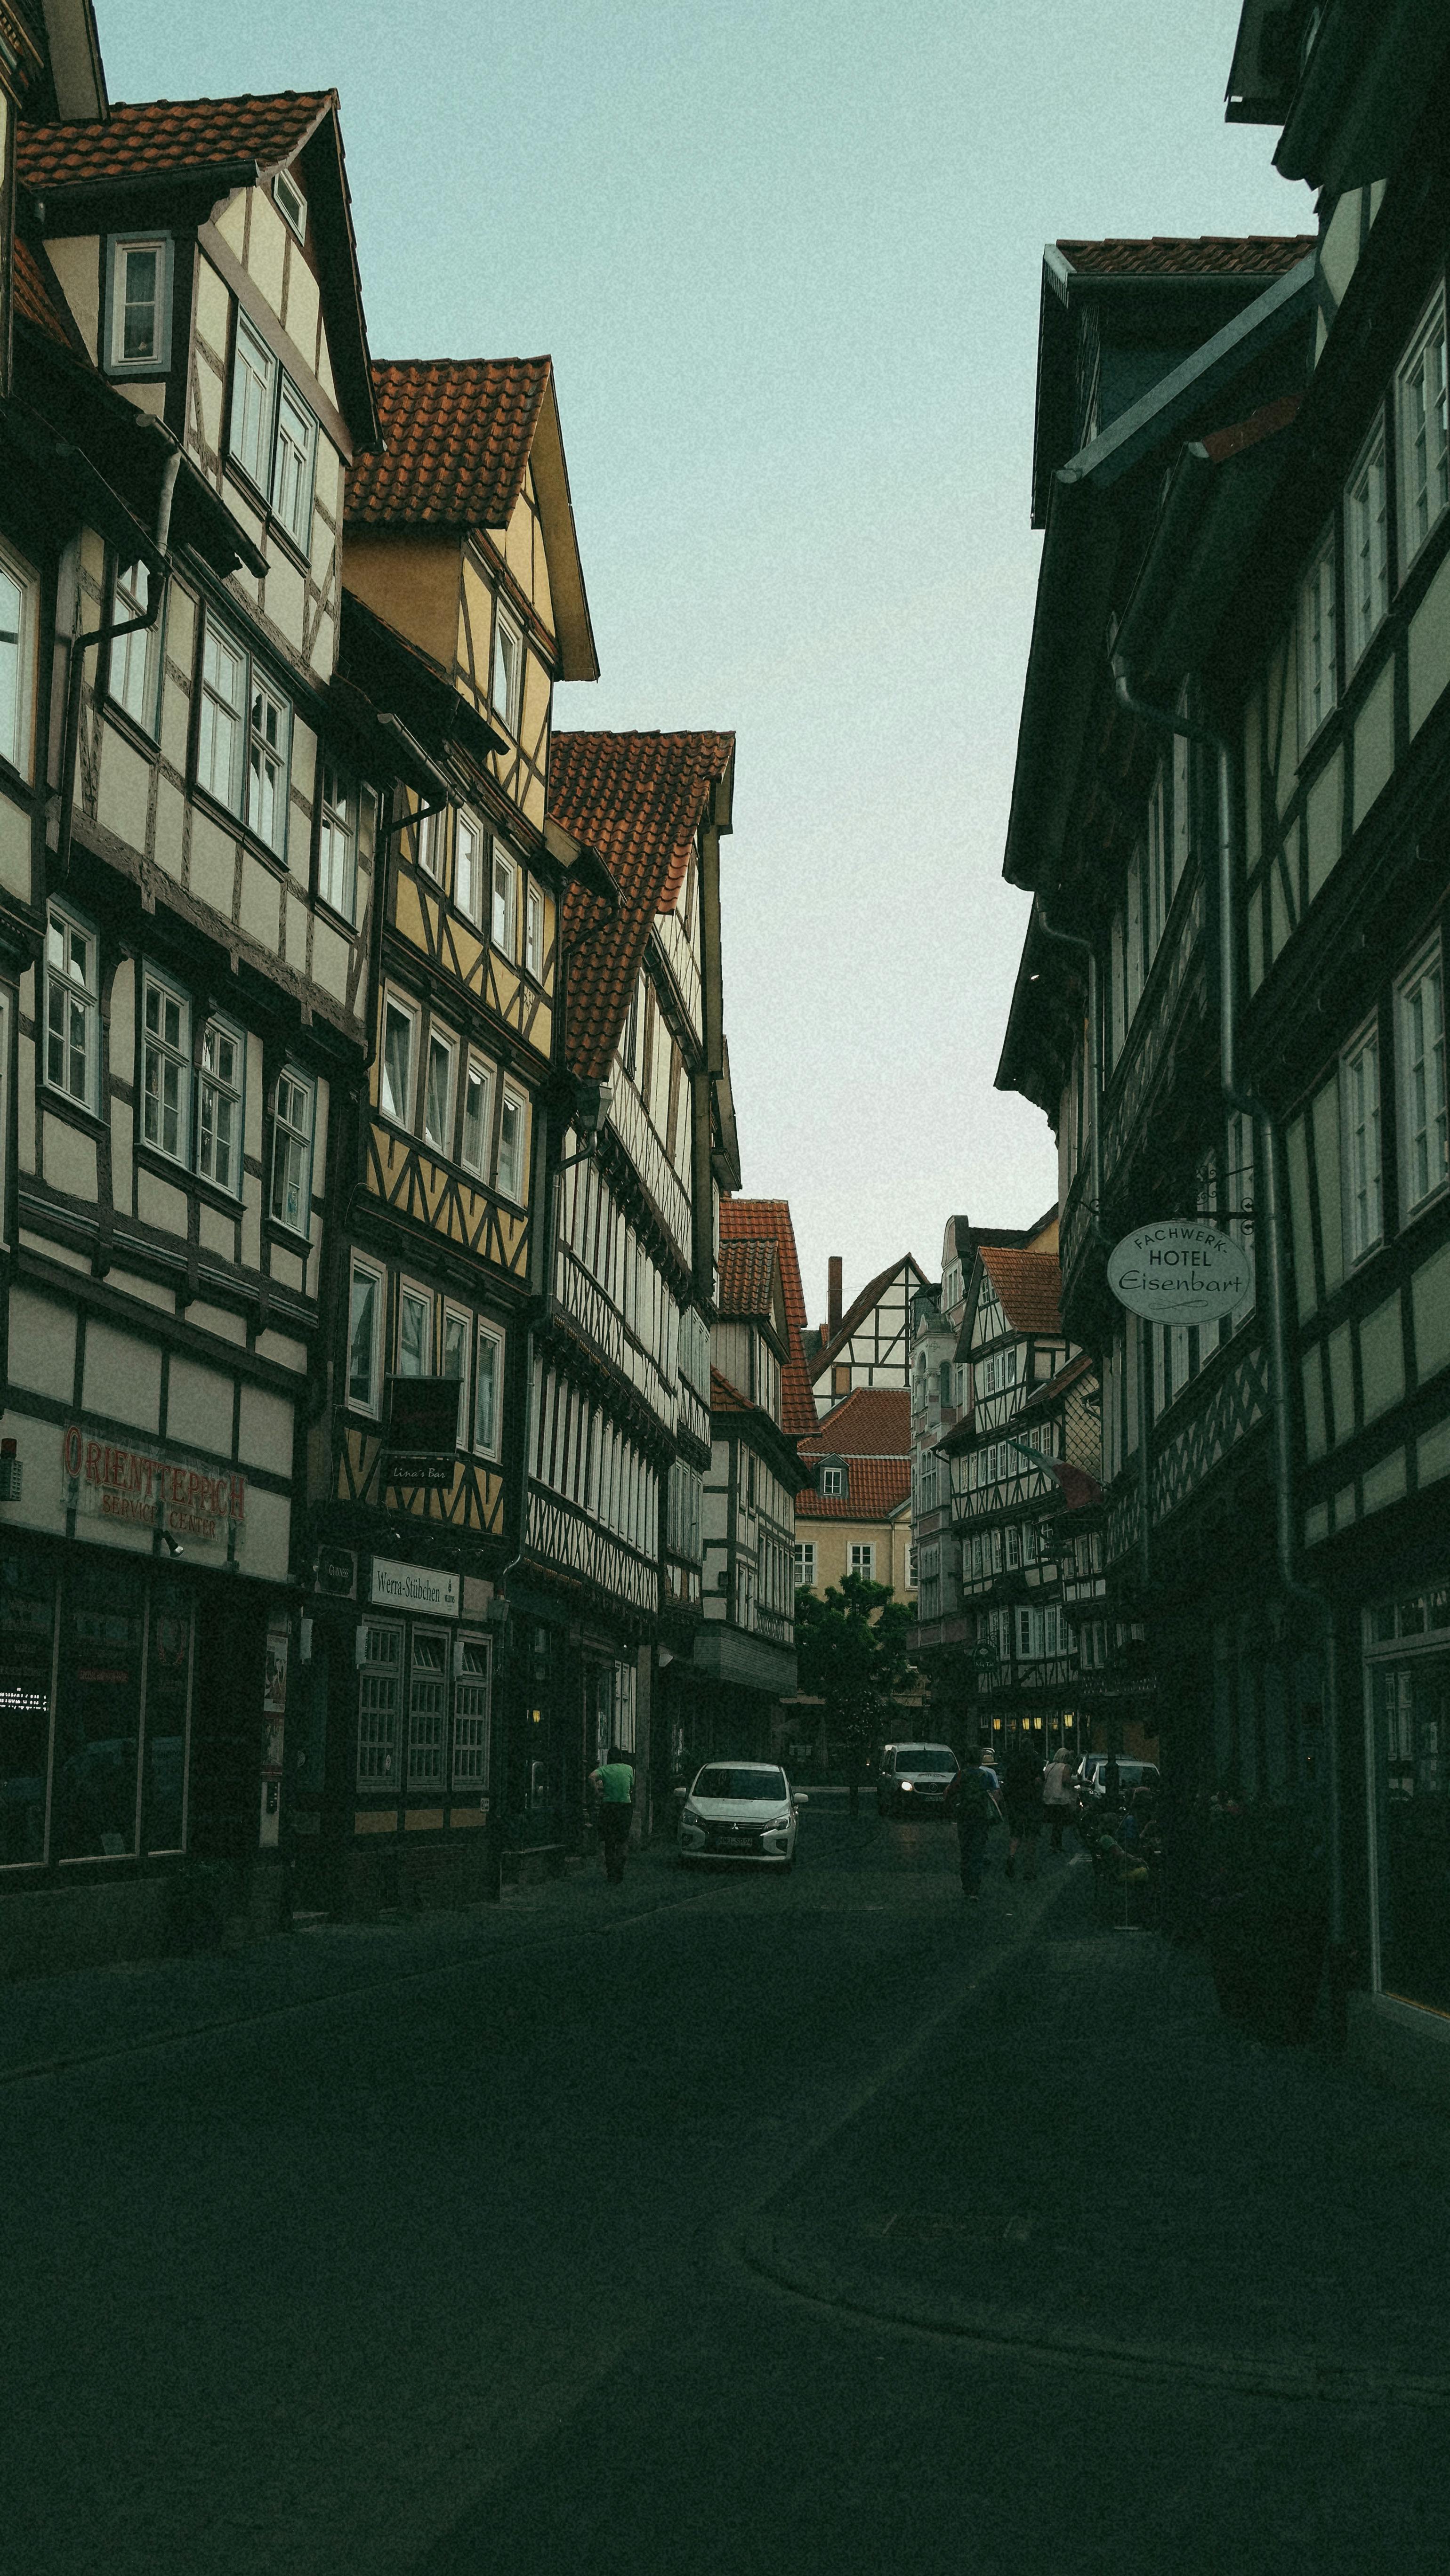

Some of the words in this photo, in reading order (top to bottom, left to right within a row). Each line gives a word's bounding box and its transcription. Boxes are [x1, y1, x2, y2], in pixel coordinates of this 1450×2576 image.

[1135, 1227, 1228, 1254] FACHWERK-
[1149, 1250, 1211, 1266] HOTEL
[1119, 1270, 1242, 1293] Eisenbart
[65, 1425, 248, 1521] ORIENTTEPPICH
[428, 1467, 446, 1478] Bar
[103, 1494, 158, 1524] SERVICE
[169, 1511, 216, 1538] CENTER
[378, 1570, 441, 1602] Werra-Stübchen
[444, 1594, 455, 1603] VELTINS
